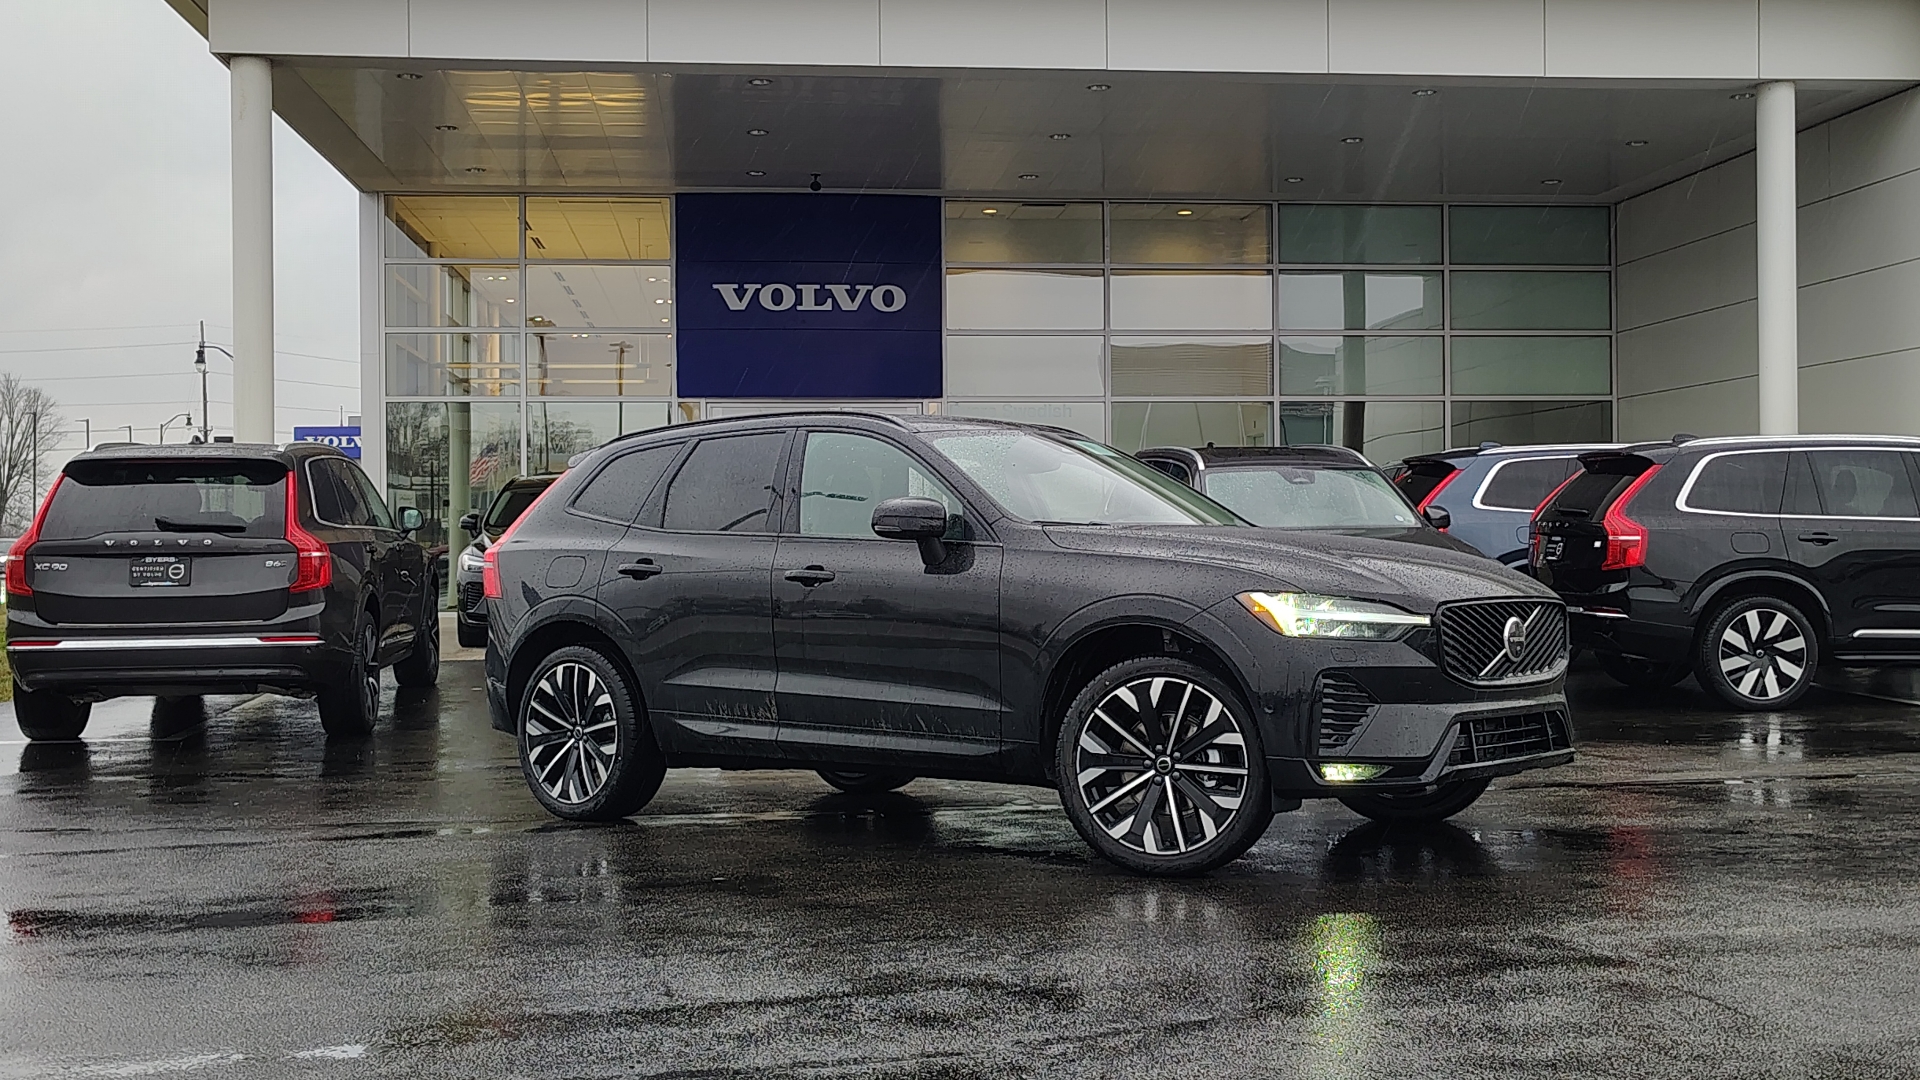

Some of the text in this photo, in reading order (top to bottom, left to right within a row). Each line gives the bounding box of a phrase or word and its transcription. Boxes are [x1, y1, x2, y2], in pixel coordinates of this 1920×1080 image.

[712, 284, 906, 312] VOLVO
[1003, 404, 1072, 418] Swedish
[303, 436, 362, 447] VOLV
